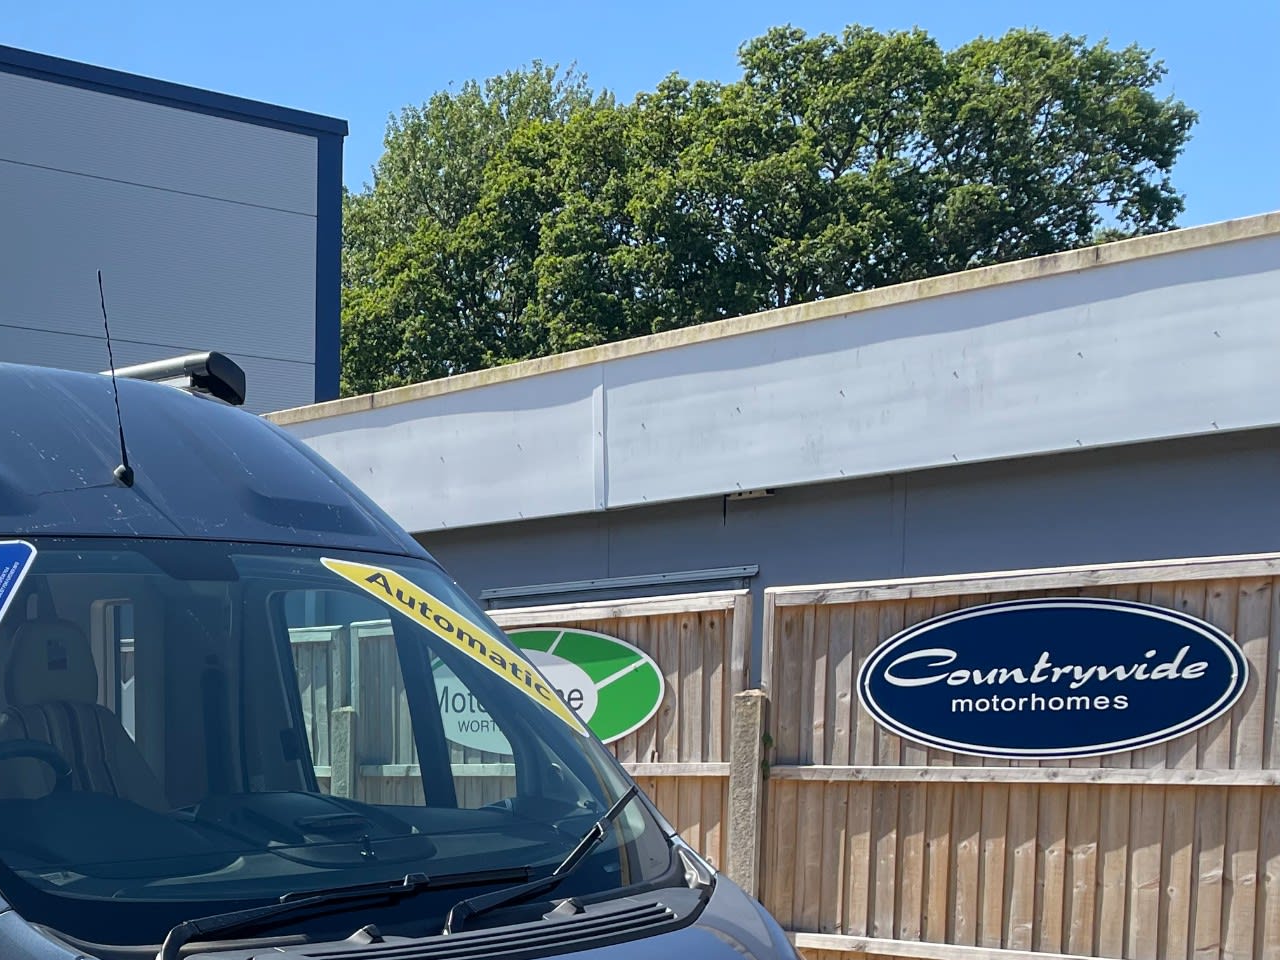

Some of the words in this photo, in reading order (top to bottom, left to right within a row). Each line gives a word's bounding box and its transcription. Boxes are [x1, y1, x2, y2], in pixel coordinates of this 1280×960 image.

[365, 573, 552, 702] Automatic
[884, 645, 1209, 689] Countrywide
[951, 693, 1129, 713] motorhomes
